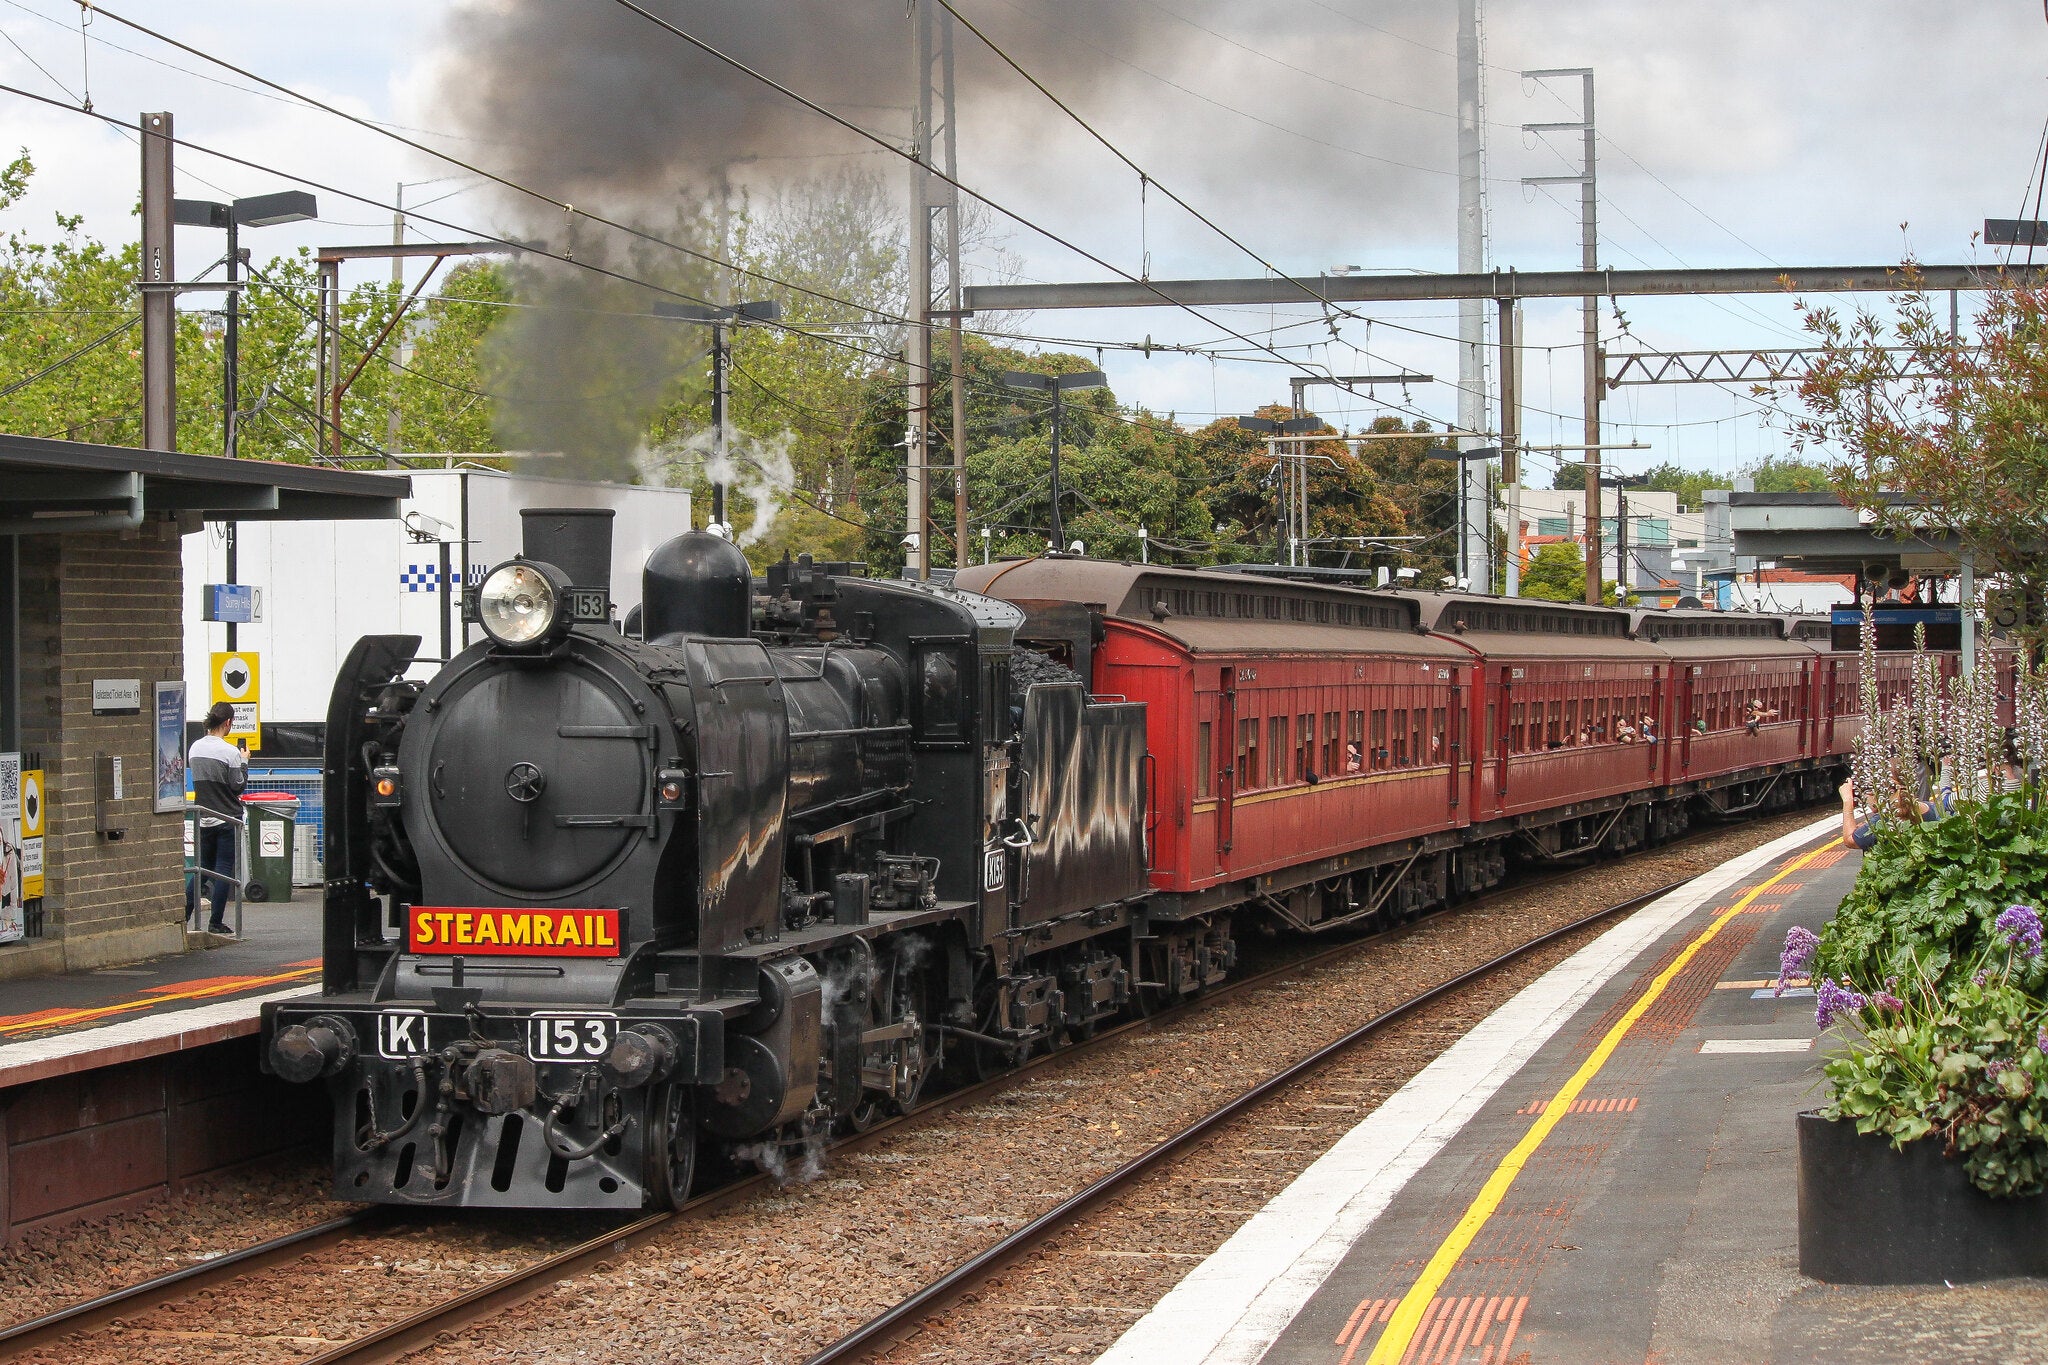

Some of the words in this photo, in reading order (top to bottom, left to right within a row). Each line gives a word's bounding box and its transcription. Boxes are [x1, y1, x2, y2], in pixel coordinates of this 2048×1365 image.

[227, 527, 234, 550] 17
[253, 589, 261, 619] 2
[576, 594, 602, 616] 153
[1995, 593, 2017, 627] 3
[416, 912, 615, 947] STEAMRAIL
[389, 1015, 417, 1053] K
[539, 1019, 608, 1056] 153
